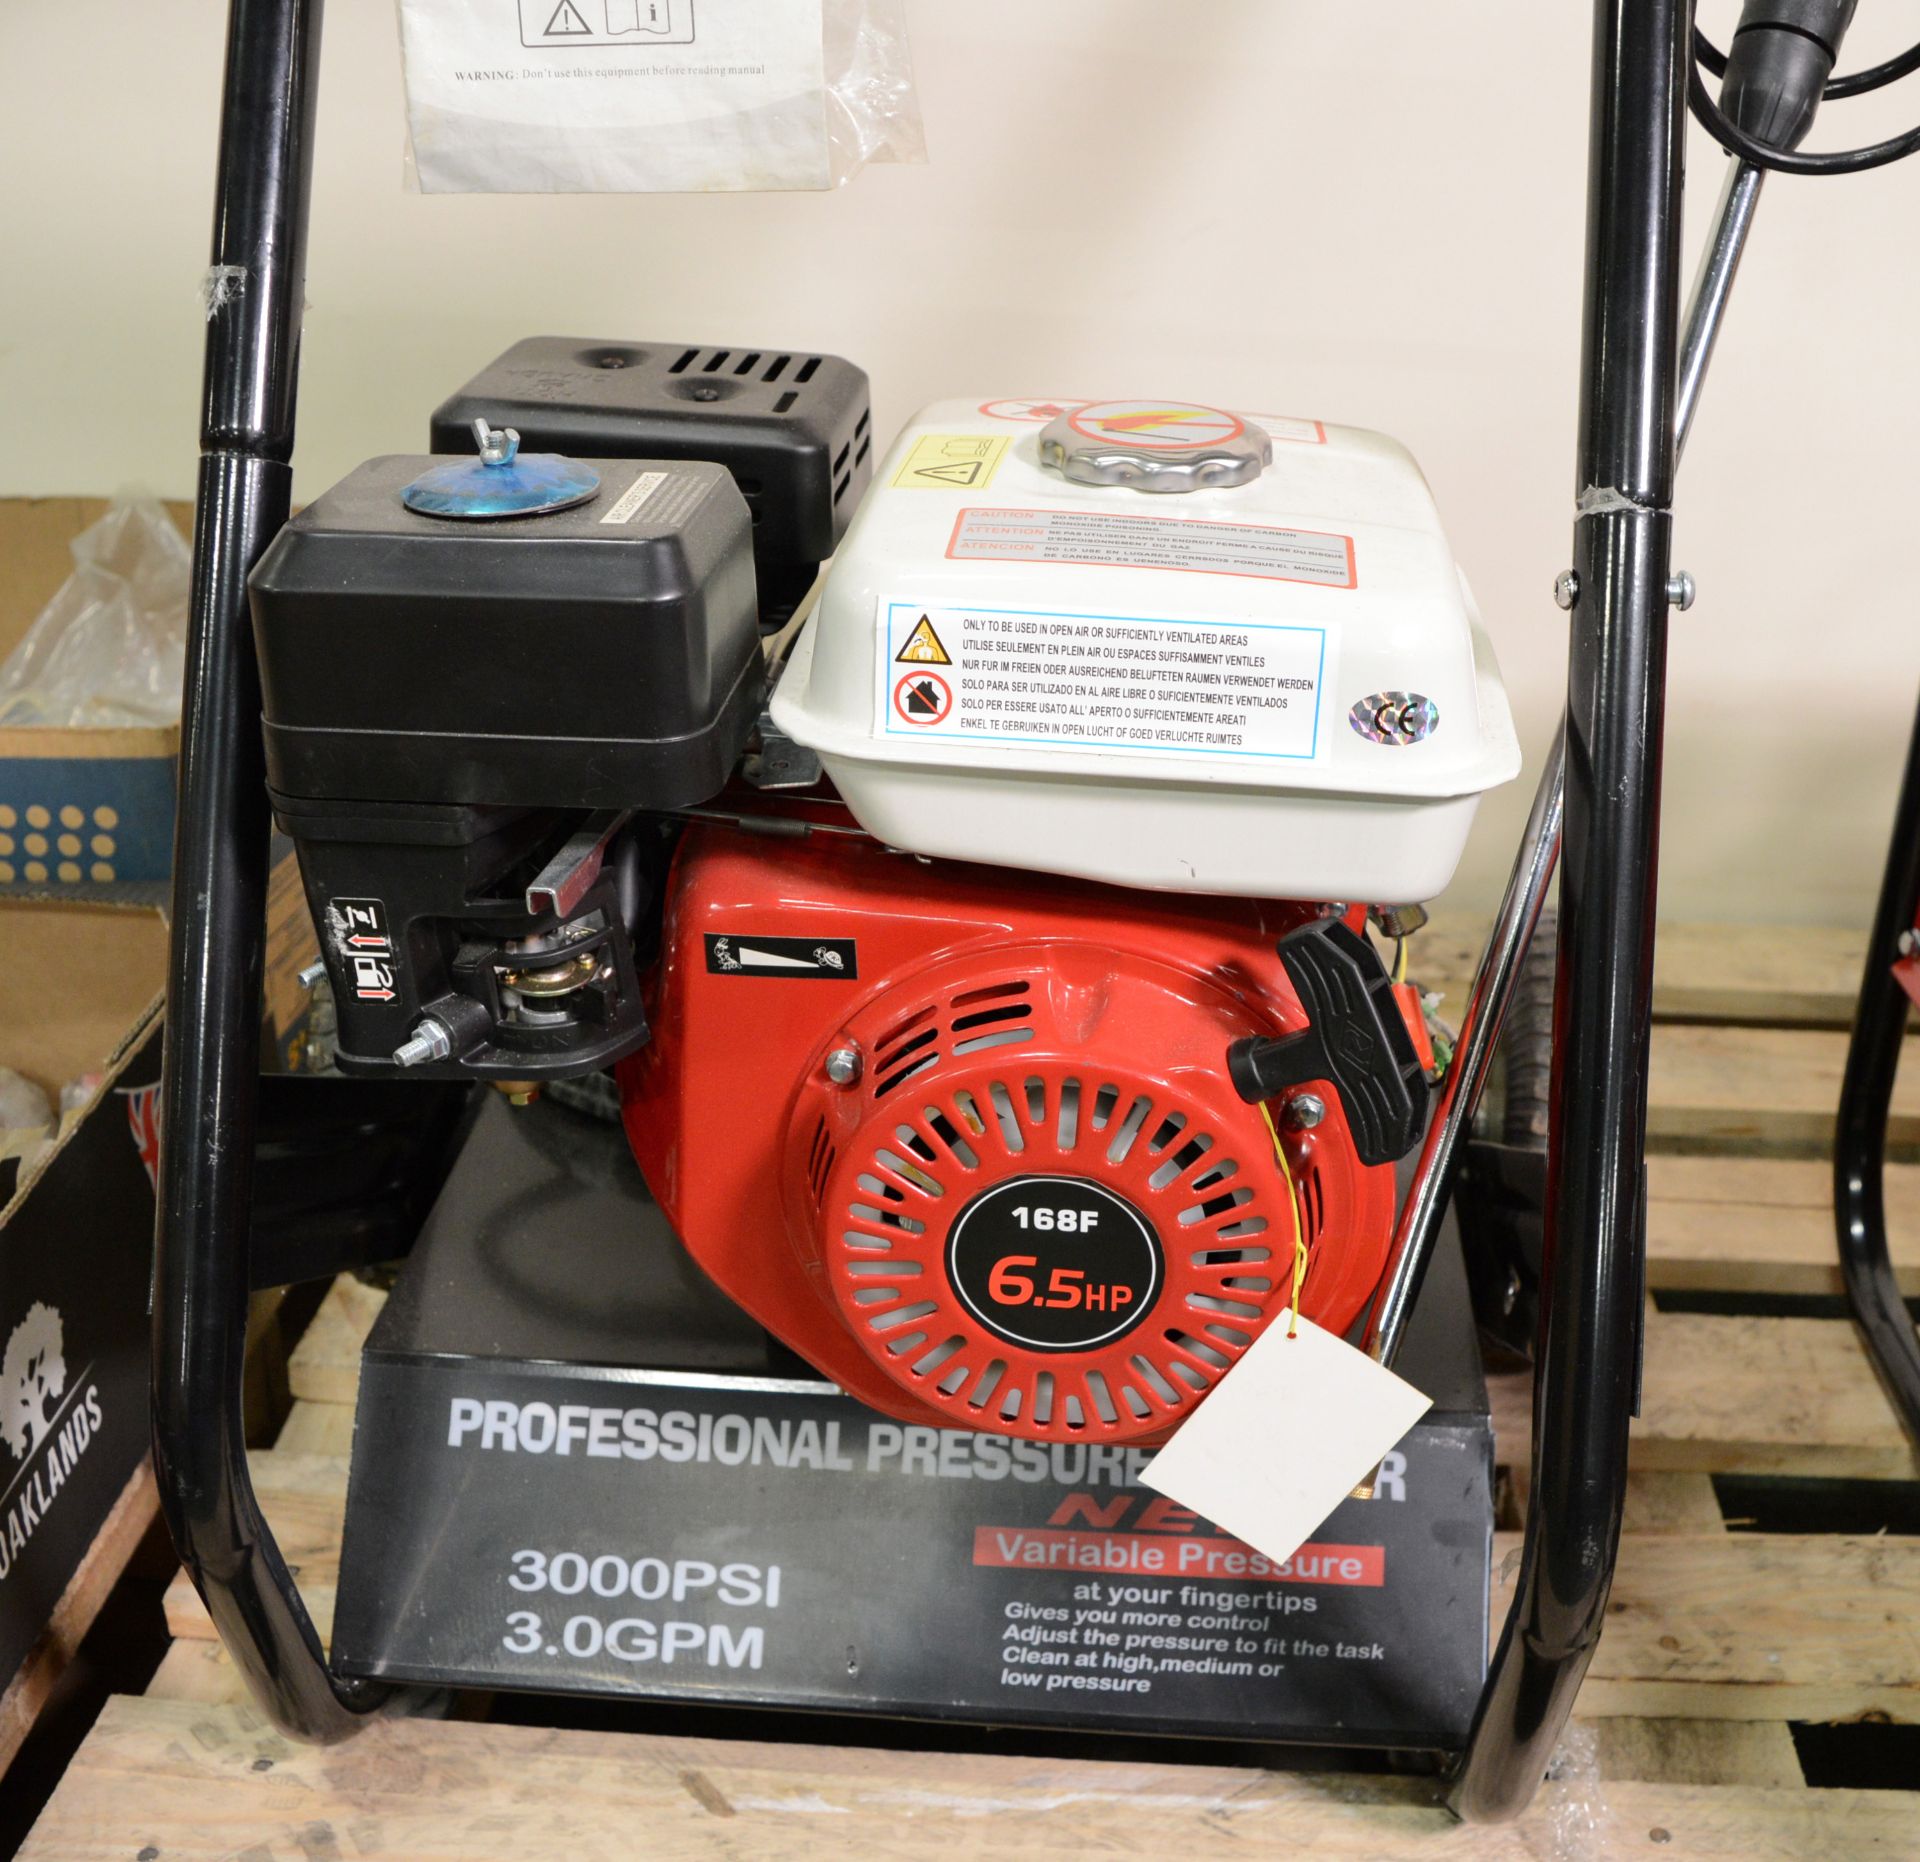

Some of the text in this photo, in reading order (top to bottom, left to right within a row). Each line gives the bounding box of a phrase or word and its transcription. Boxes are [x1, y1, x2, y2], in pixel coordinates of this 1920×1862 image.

[453, 63, 765, 82] WARNING: Don't use this equipment before reading manual
[970, 510, 1034, 519] CAUTION
[966, 526, 1044, 536] ATTENTION
[1196, 524, 1237, 533] DANGER
[1254, 529, 1297, 538] CARBON
[960, 542, 1034, 551] ATENCION
[1062, 554, 1112, 562] CARBONO
[1259, 545, 1290, 553] CAUSE
[1123, 551, 1170, 559] LUGARES
[1293, 565, 1346, 576] MONOXIDE
[962, 618, 1248, 647] ONLY TO BE USED IN OPEN AIR OR SUFFICIENTLY VENTILATED AREAS
[961, 639, 1265, 668] UTILISE SEULEMENT EN PLEIN AIR OU ESPACES SUFFISAMMENT VENTILES
[961, 658, 1314, 691] NUR FUR IM FREIEN ODER AUSREICHEND BELUFTETEN RAUMEN VERWENDET WERDEN
[960, 678, 1288, 709] SOLO PARA SER UTILIZADO EN AL AIRE LIBRE O SUFICIENTEMENTE VENTILADOS
[960, 697, 1247, 726] SOLO PER ESSERE USATO ALL' APERTO O SUFFICIENTEMENTE AREATI
[1374, 702, 1418, 736] CE
[959, 717, 1242, 746] ENKEL TE GEBRUIKEN IN OPEN LUCHT OF GOED VERLUCHTE RUIMTES
[1011, 1206, 1099, 1233] 168F
[988, 1255, 1133, 1312] 6.5HP
[447, 1397, 853, 1472] PROFESSIONAL
[1046, 1493, 1231, 1536] NE
[996, 1532, 1363, 1580] Variable Pressure
[507, 1548, 781, 1608] 3000PSI
[1073, 1581, 1318, 1615] at your fingertips
[1004, 1601, 1269, 1631] Gives you more control
[502, 1610, 764, 1669] 3.0GPM
[1001, 1623, 1385, 1660] Adjust the pressure to fit the task
[1002, 1645, 1284, 1677] Clean at high,medium or
[1000, 1667, 1151, 1693] low pressure
